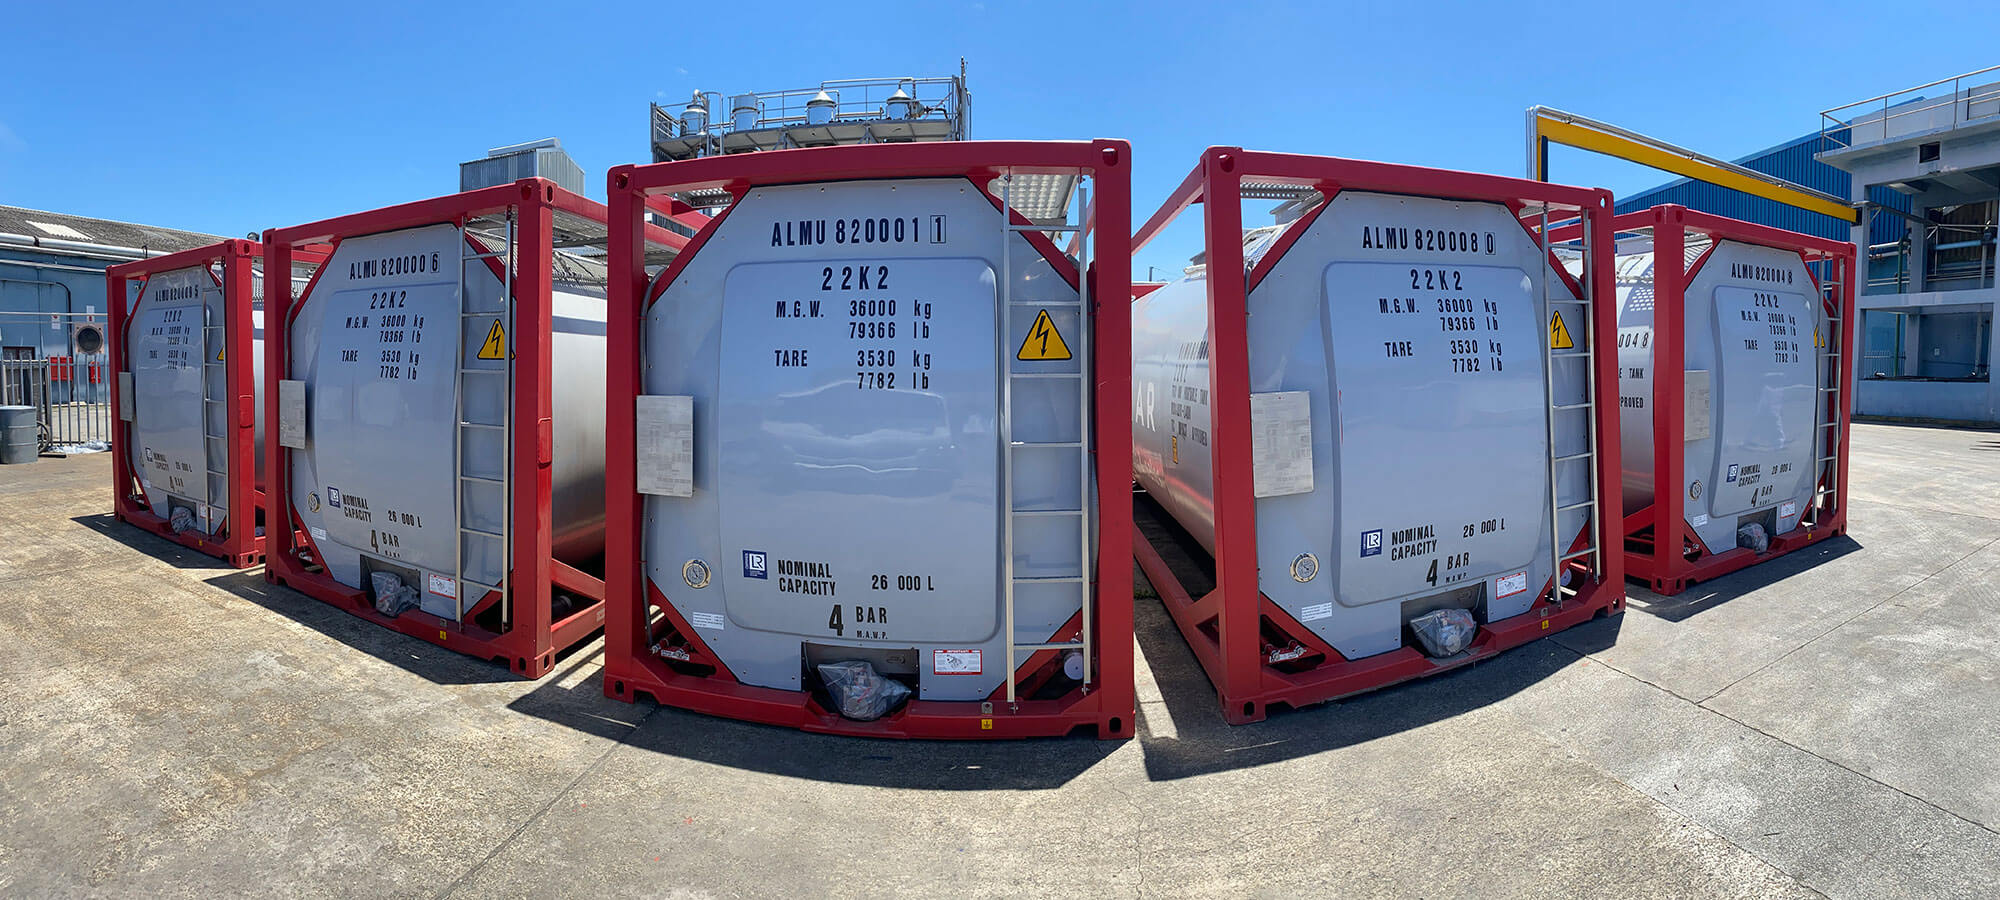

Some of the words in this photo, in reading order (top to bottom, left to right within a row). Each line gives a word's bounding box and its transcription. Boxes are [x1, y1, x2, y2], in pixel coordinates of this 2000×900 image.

[771, 220, 826, 247] ALMU
[836, 217, 919, 244] 820001
[933, 216, 944, 243] 1
[1362, 226, 1408, 250] ALMU
[1415, 229, 1478, 252] 820008
[1486, 232, 1494, 254] 0
[350, 260, 377, 280] ALMU
[381, 254, 426, 276] 820000
[432, 252, 439, 272] 6
[1732, 262, 1753, 280] ALMU
[822, 266, 889, 290] 22K2
[1410, 269, 1462, 290] 22K2
[370, 290, 407, 310] 22K2
[776, 301, 824, 318] M.G.W.
[850, 300, 896, 317] 36000
[914, 300, 932, 319] kg
[1379, 298, 1420, 314] M.G.W.
[1437, 298, 1473, 313] 36000
[1484, 299, 1498, 315] kg
[414, 315, 424, 330] kg
[850, 322, 896, 339] 79366
[914, 322, 929, 339] lb
[1440, 317, 1476, 332] 79366
[1486, 316, 1499, 330] lb
[379, 330, 404, 343] 79366
[412, 329, 421, 343] lb
[342, 350, 358, 362] TARE
[380, 350, 400, 363] 3530
[409, 350, 420, 366] kg
[1384, 341, 1414, 358] TARE
[1450, 340, 1478, 354] 3530
[1489, 340, 1502, 356] kg
[775, 350, 808, 367] TARE
[858, 350, 895, 367] 3530
[913, 350, 931, 370] kg
[1452, 358, 1480, 373] 7782
[1491, 358, 1502, 372] lb
[407, 366, 417, 380] lb
[858, 372, 895, 390] 7782
[913, 372, 929, 390] lb
[1629, 368, 1644, 379] TANK
[342, 494, 369, 510] NOMINAL
[1752, 488, 1759, 508] 4
[344, 506, 372, 523] CAPACITY
[388, 510, 397, 522] 26
[402, 513, 414, 526] 000
[417, 516, 422, 528] L
[371, 530, 379, 554] 4
[382, 532, 400, 548] BAR
[1392, 524, 1435, 546] NOMINAL
[1392, 539, 1438, 561] CAPACITY
[1462, 524, 1474, 538] 26
[1481, 519, 1496, 535] 000
[1500, 518, 1505, 532] L
[751, 555, 763, 569] LR
[778, 560, 832, 579] NOMINAL
[1426, 559, 1438, 586] 4
[1447, 552, 1470, 570] BAR
[779, 578, 836, 596] CAPACITY
[872, 574, 888, 590] 26
[898, 575, 921, 591] 000
[928, 576, 934, 591] L
[829, 604, 844, 636] 4
[856, 606, 888, 624] BAR
